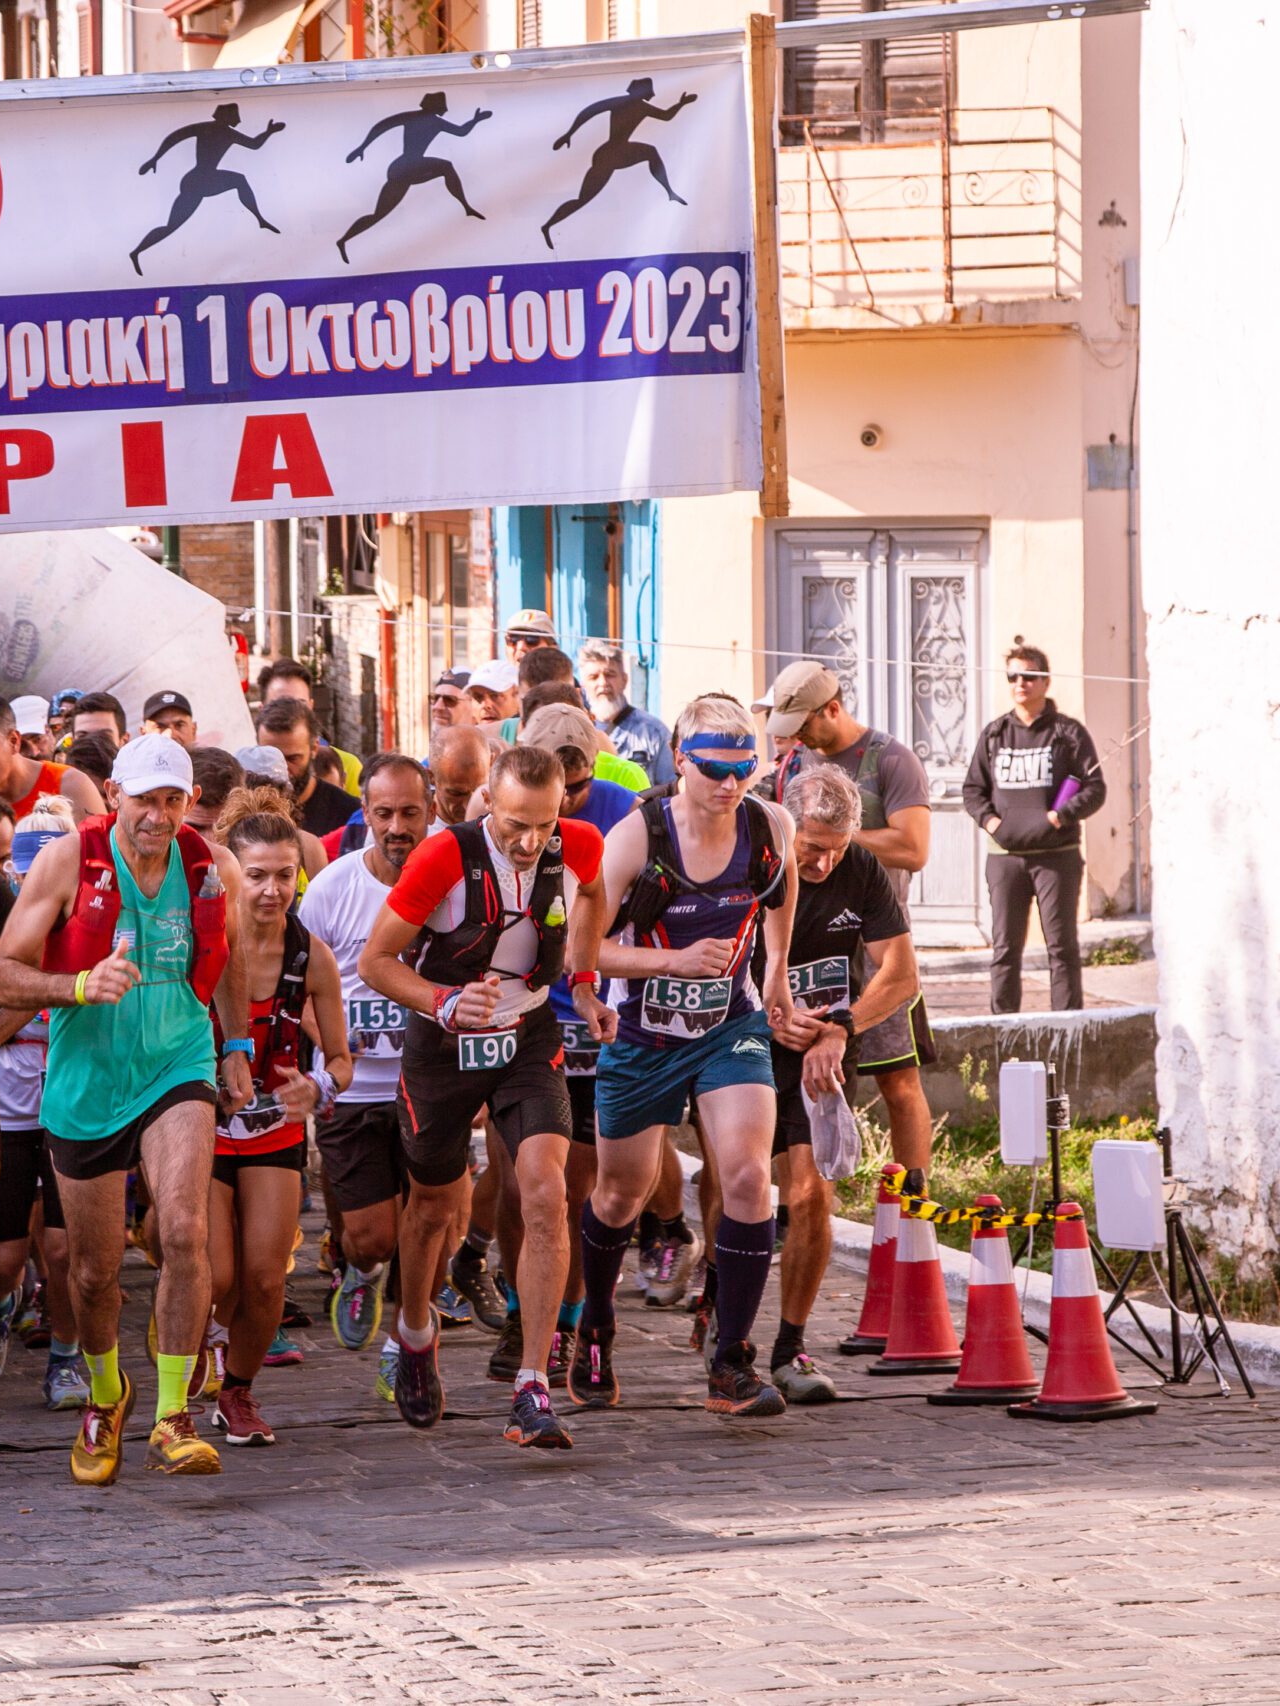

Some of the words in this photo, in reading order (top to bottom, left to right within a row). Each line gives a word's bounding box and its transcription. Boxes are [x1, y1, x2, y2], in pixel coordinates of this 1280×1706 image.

[196, 294, 229, 385] 1
[247, 275, 586, 379] Οκτωβρίου
[596, 265, 741, 358] 2023
[648, 978, 702, 1010] 158
[787, 966, 816, 994] 31
[351, 999, 402, 1029] 155
[464, 1034, 517, 1068] 190
[563, 1024, 578, 1049] 5
